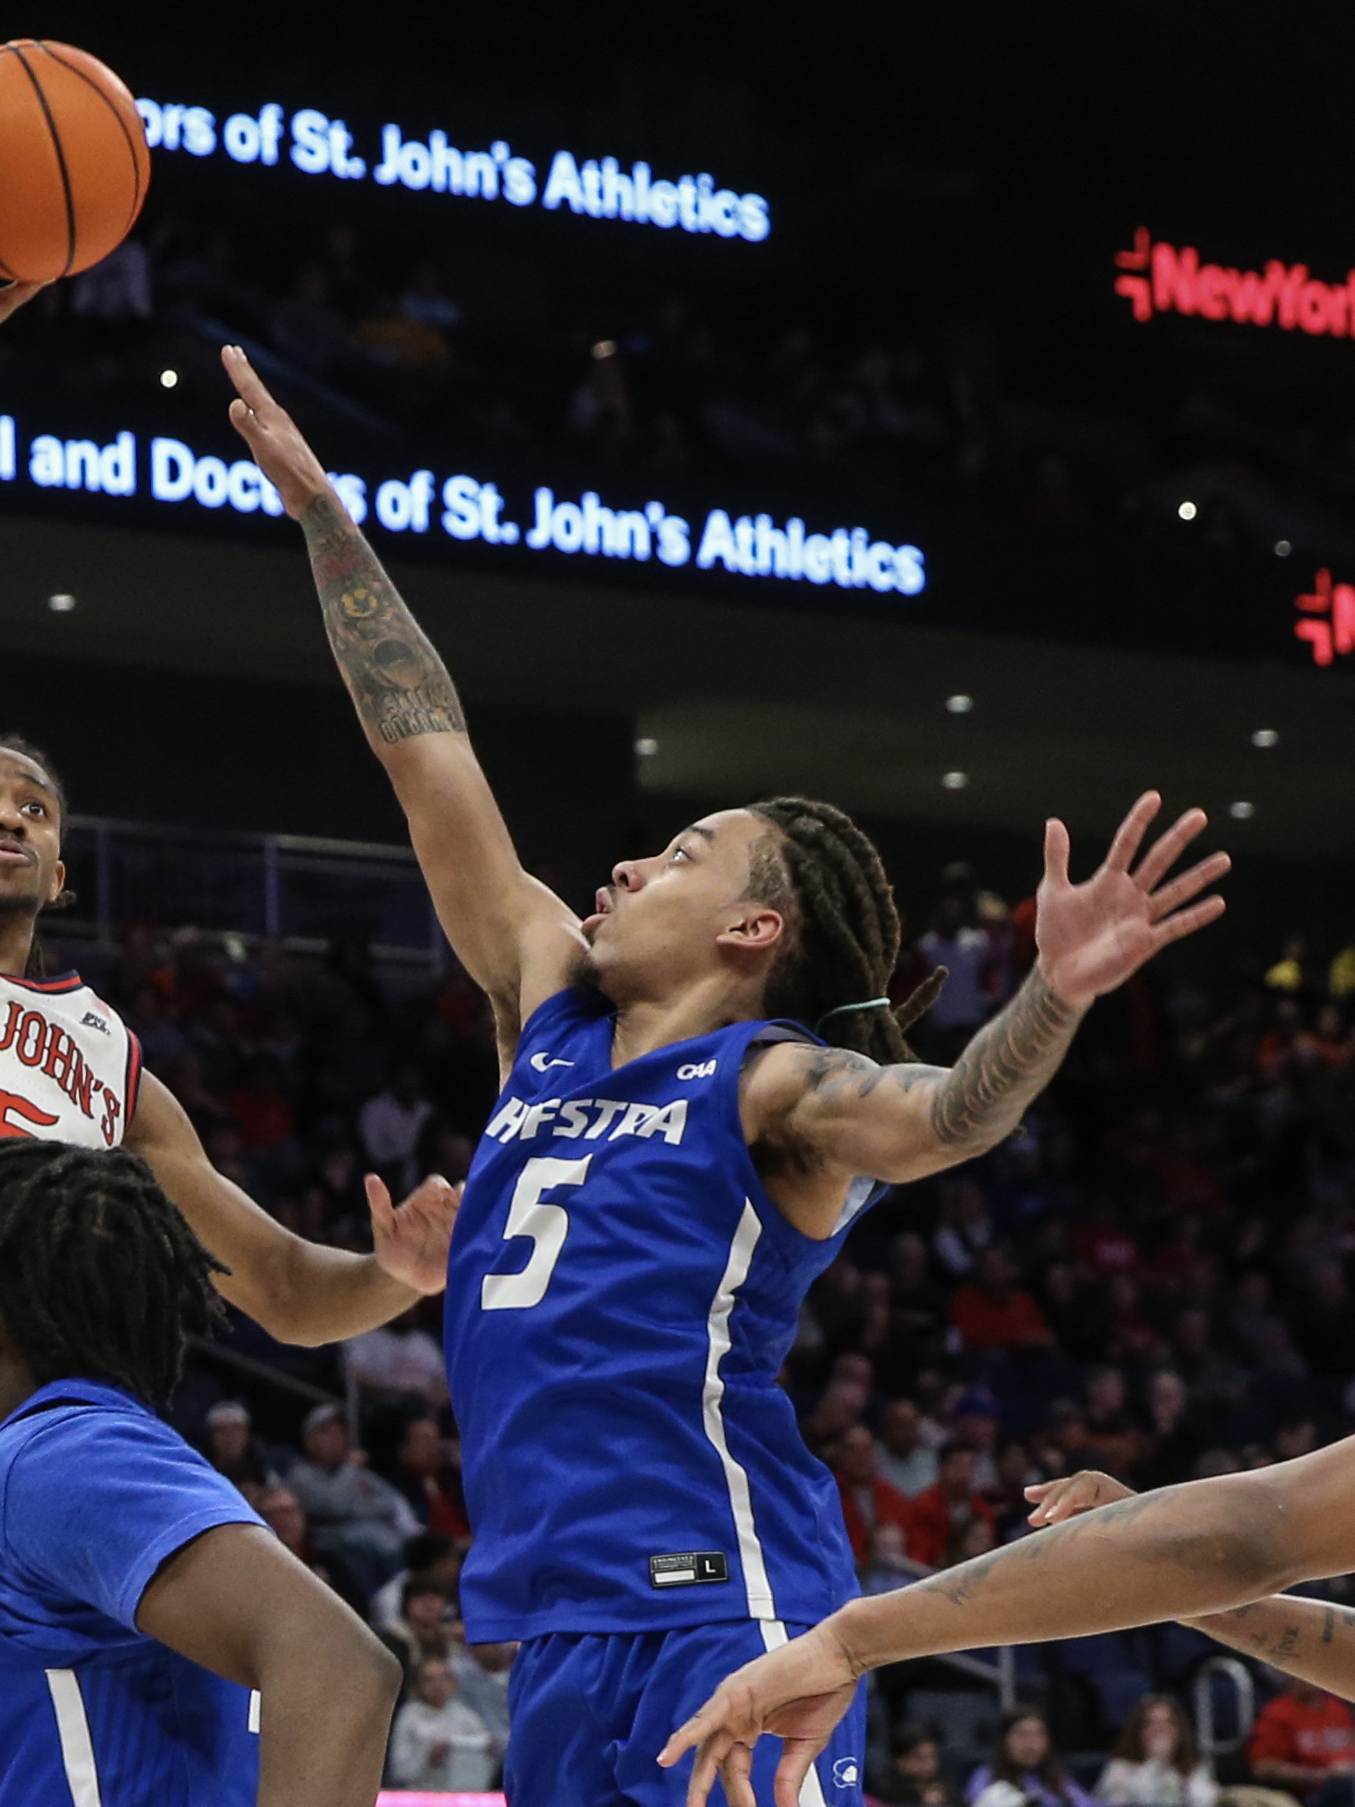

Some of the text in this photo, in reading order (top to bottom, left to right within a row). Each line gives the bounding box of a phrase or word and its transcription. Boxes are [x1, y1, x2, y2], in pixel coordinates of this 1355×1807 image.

[223, 102, 283, 166] of
[290, 108, 367, 181] St.
[373, 123, 537, 207] John's
[542, 150, 771, 243] Athletics
[1150, 241, 1355, 339] NewYor
[29, 430, 136, 497] and
[375, 470, 434, 533] of
[442, 474, 520, 544] St.
[526, 486, 691, 567] John's
[695, 509, 926, 596] Athletics
[676, 1059, 718, 1081] CAA
[485, 1096, 689, 1146] HFSTRA
[481, 1152, 594, 1311] 5
[705, 1560, 716, 1573] L
